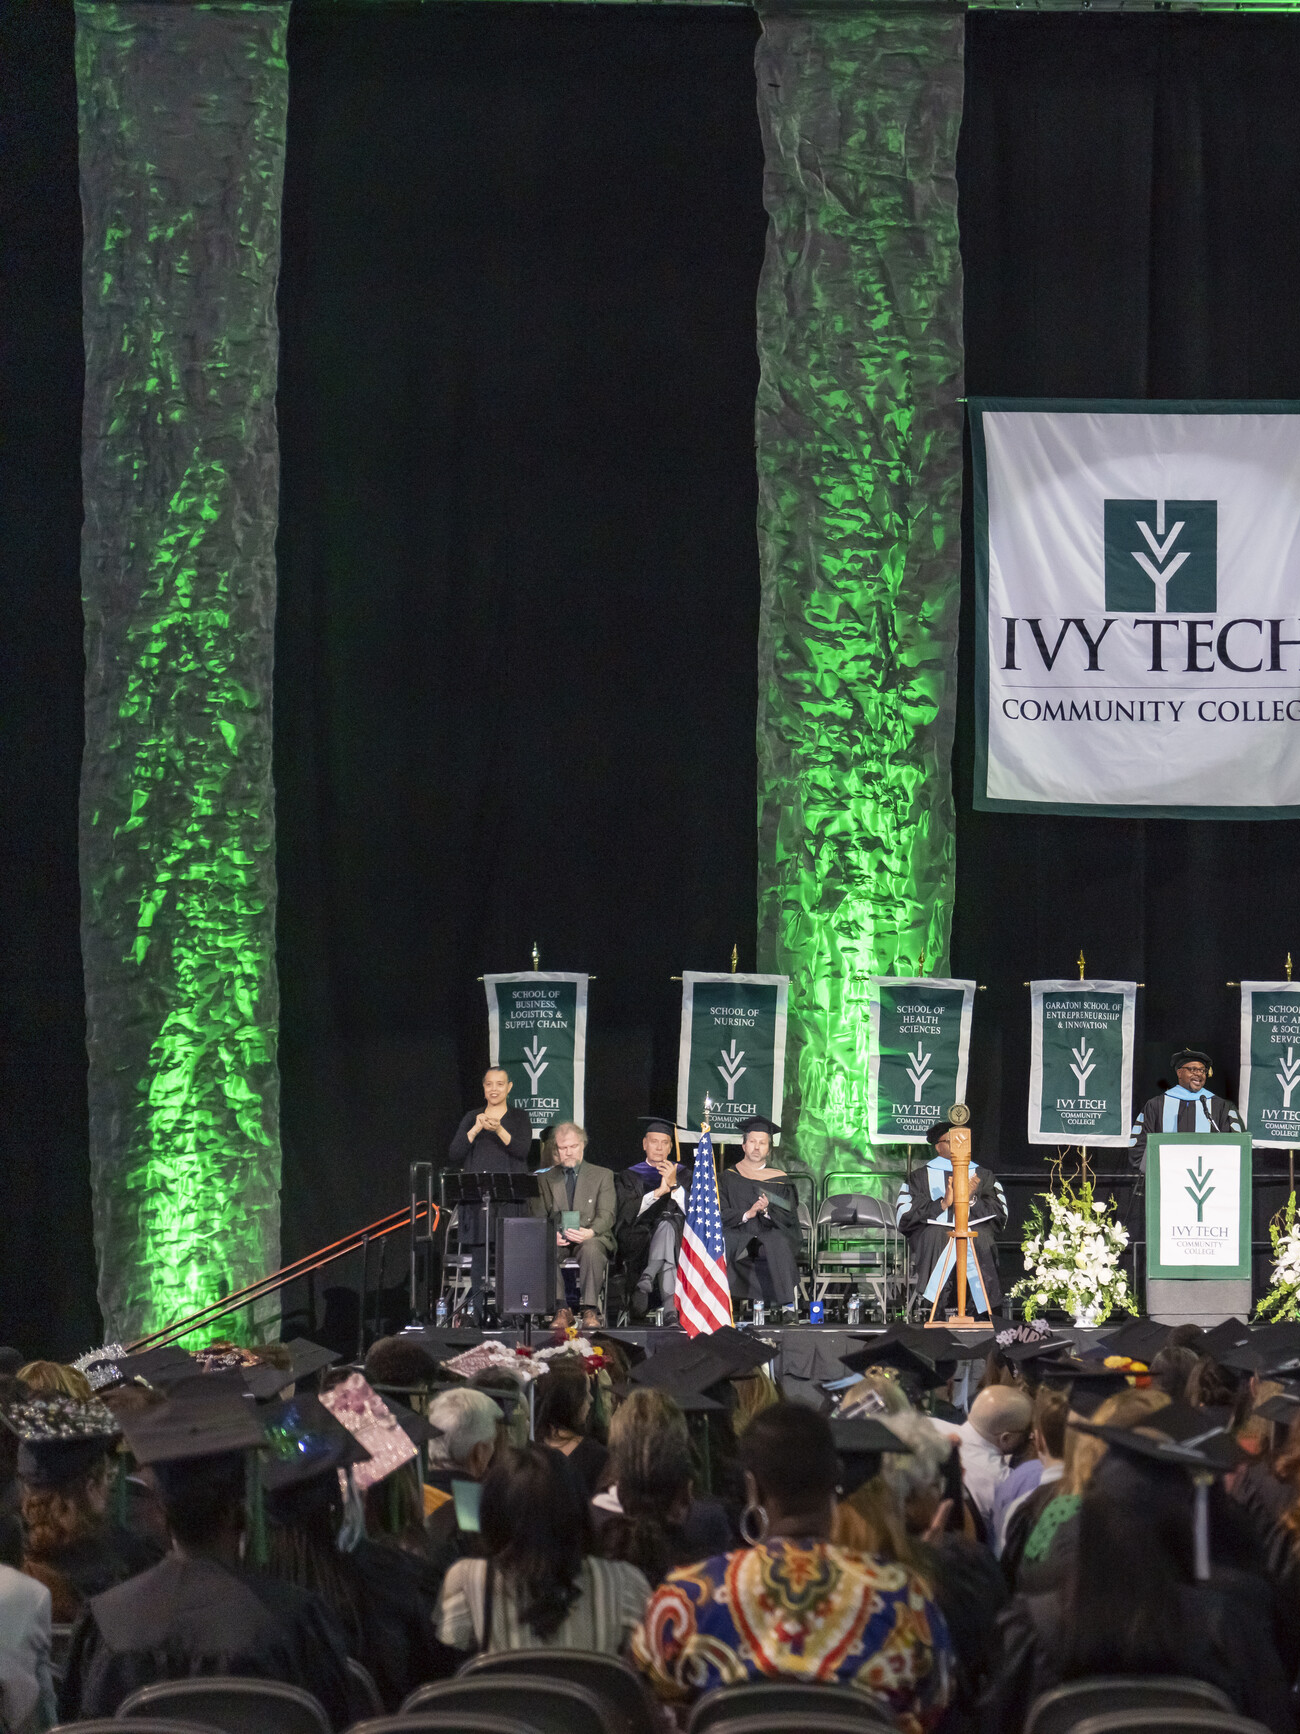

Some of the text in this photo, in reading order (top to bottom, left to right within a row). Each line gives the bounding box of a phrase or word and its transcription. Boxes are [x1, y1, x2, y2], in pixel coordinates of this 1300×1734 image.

[1000, 617, 1119, 672] IVY
[1002, 699, 1186, 722] COMMUNITY
[897, 1005, 932, 1013] SCHOOL
[1084, 1002, 1110, 1010] SCHOOL
[511, 1011, 553, 1019] LOGISTICS
[710, 1007, 745, 1016] SCHOOL
[1047, 1011, 1120, 1020] ENTREPRENEURSHIP
[714, 1018, 755, 1026] NURSING
[903, 1016, 938, 1024] HEALTH
[1256, 1015, 1288, 1023] PUBLIC
[506, 1021, 535, 1029] SUPPLY
[900, 1025, 941, 1034] SCIENCES
[515, 1098, 559, 1108] IVY TECH
[1057, 1099, 1106, 1109] IVY TECH
[710, 1103, 756, 1113] VY TECH
[892, 1104, 940, 1115] IVY TECH
[1262, 1109, 1280, 1119] IVY
[1172, 1226, 1228, 1237] IVY TECH
